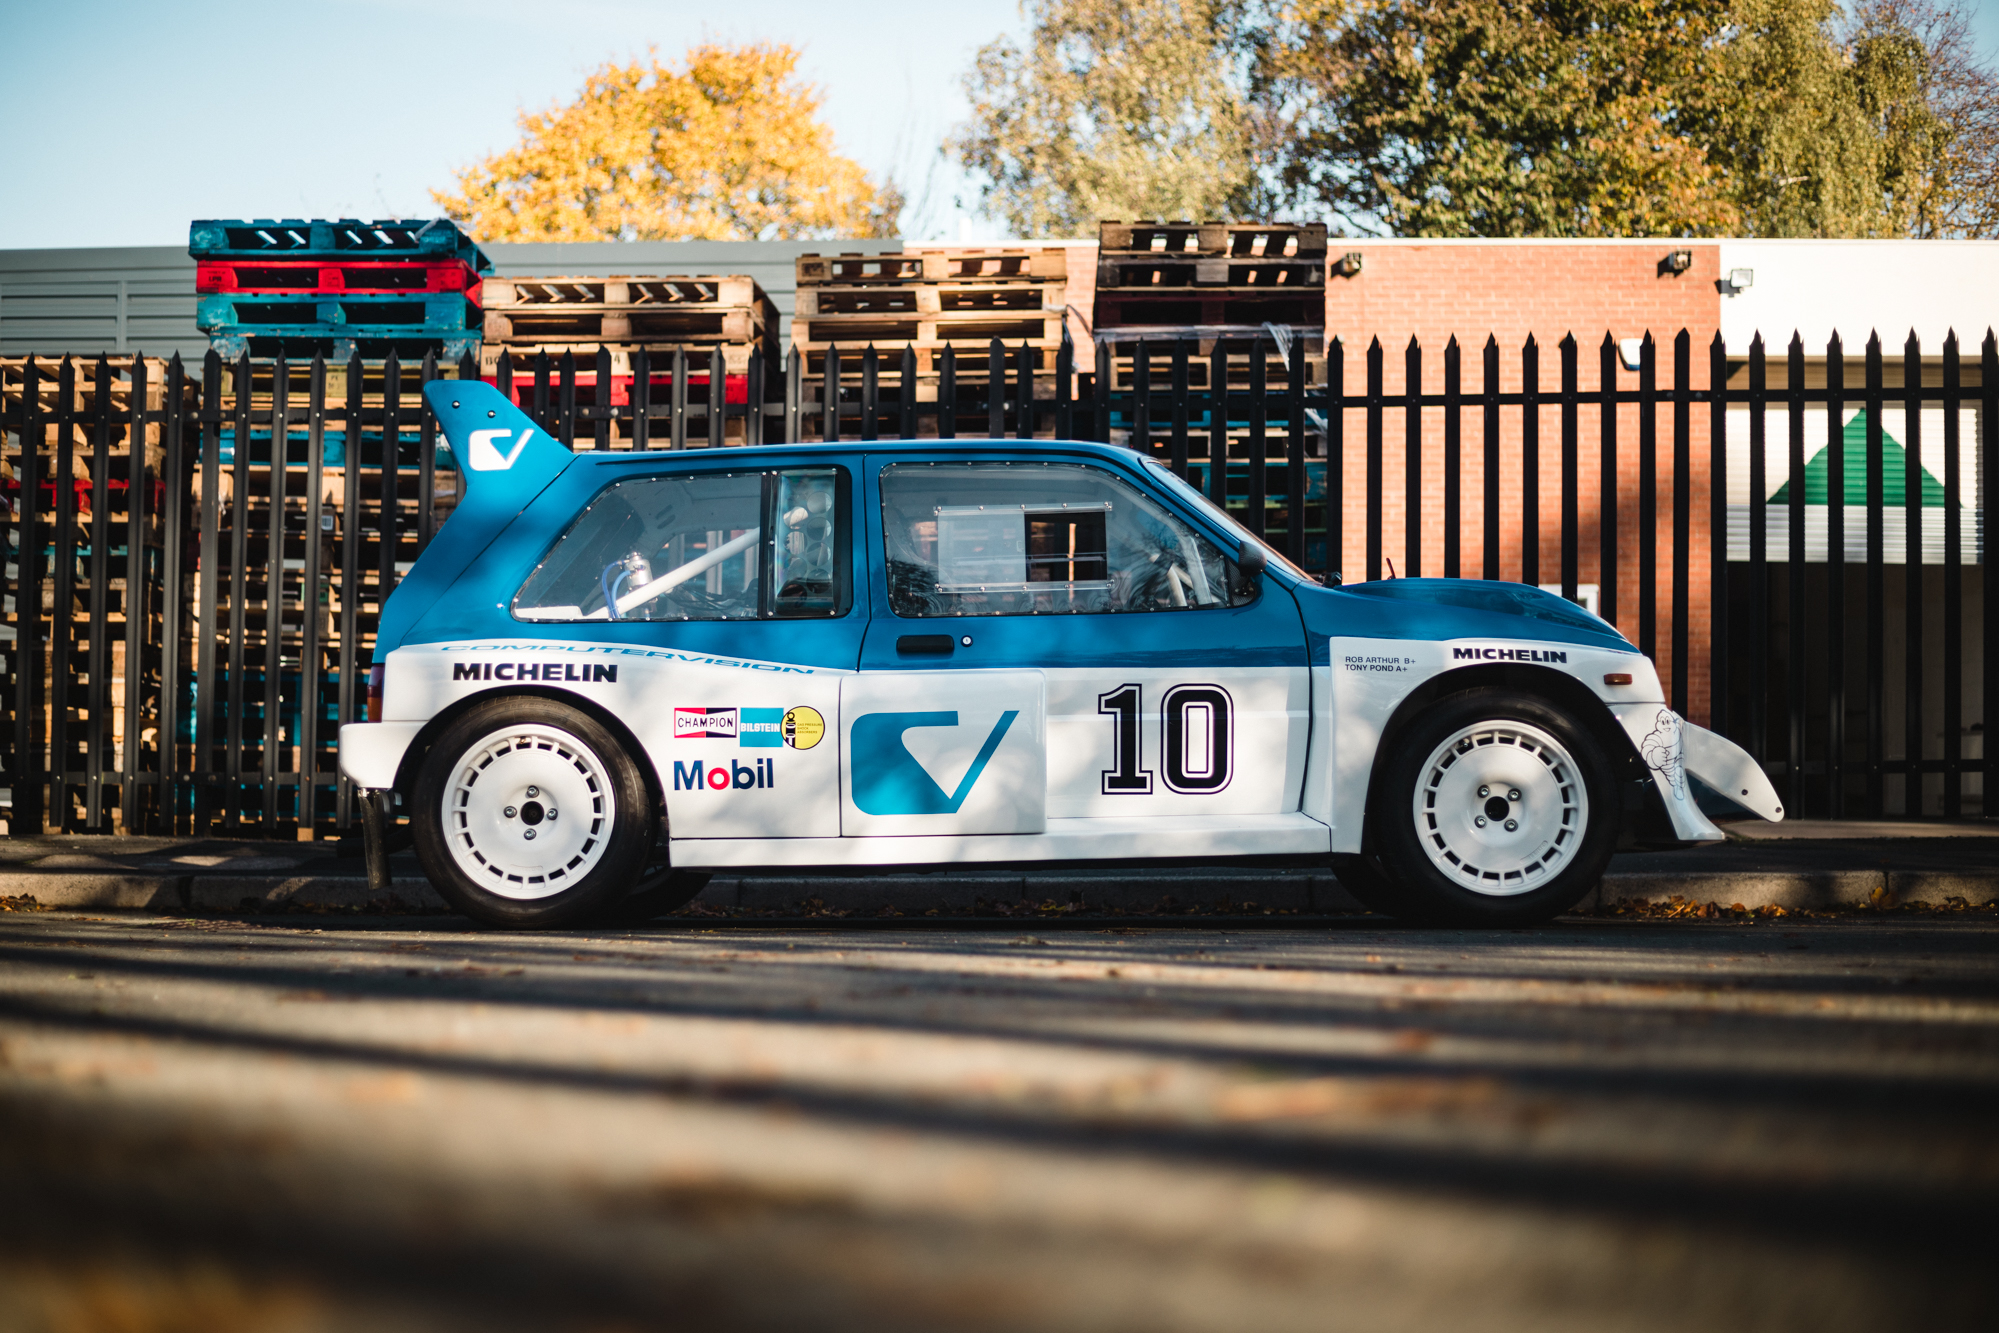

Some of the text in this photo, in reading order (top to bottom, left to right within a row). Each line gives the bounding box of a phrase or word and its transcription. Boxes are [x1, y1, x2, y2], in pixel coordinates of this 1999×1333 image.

[441, 645, 815, 674] COMPUTERVISION
[1453, 648, 1567, 664] MICHELIN
[453, 662, 618, 683] MICHELIN
[1369, 664, 1394, 672] POND
[677, 717, 734, 728] CHAMPION
[740, 722, 781, 732] BILSTEIN
[1098, 683, 1234, 795] 10
[673, 758, 774, 791] Mobil
